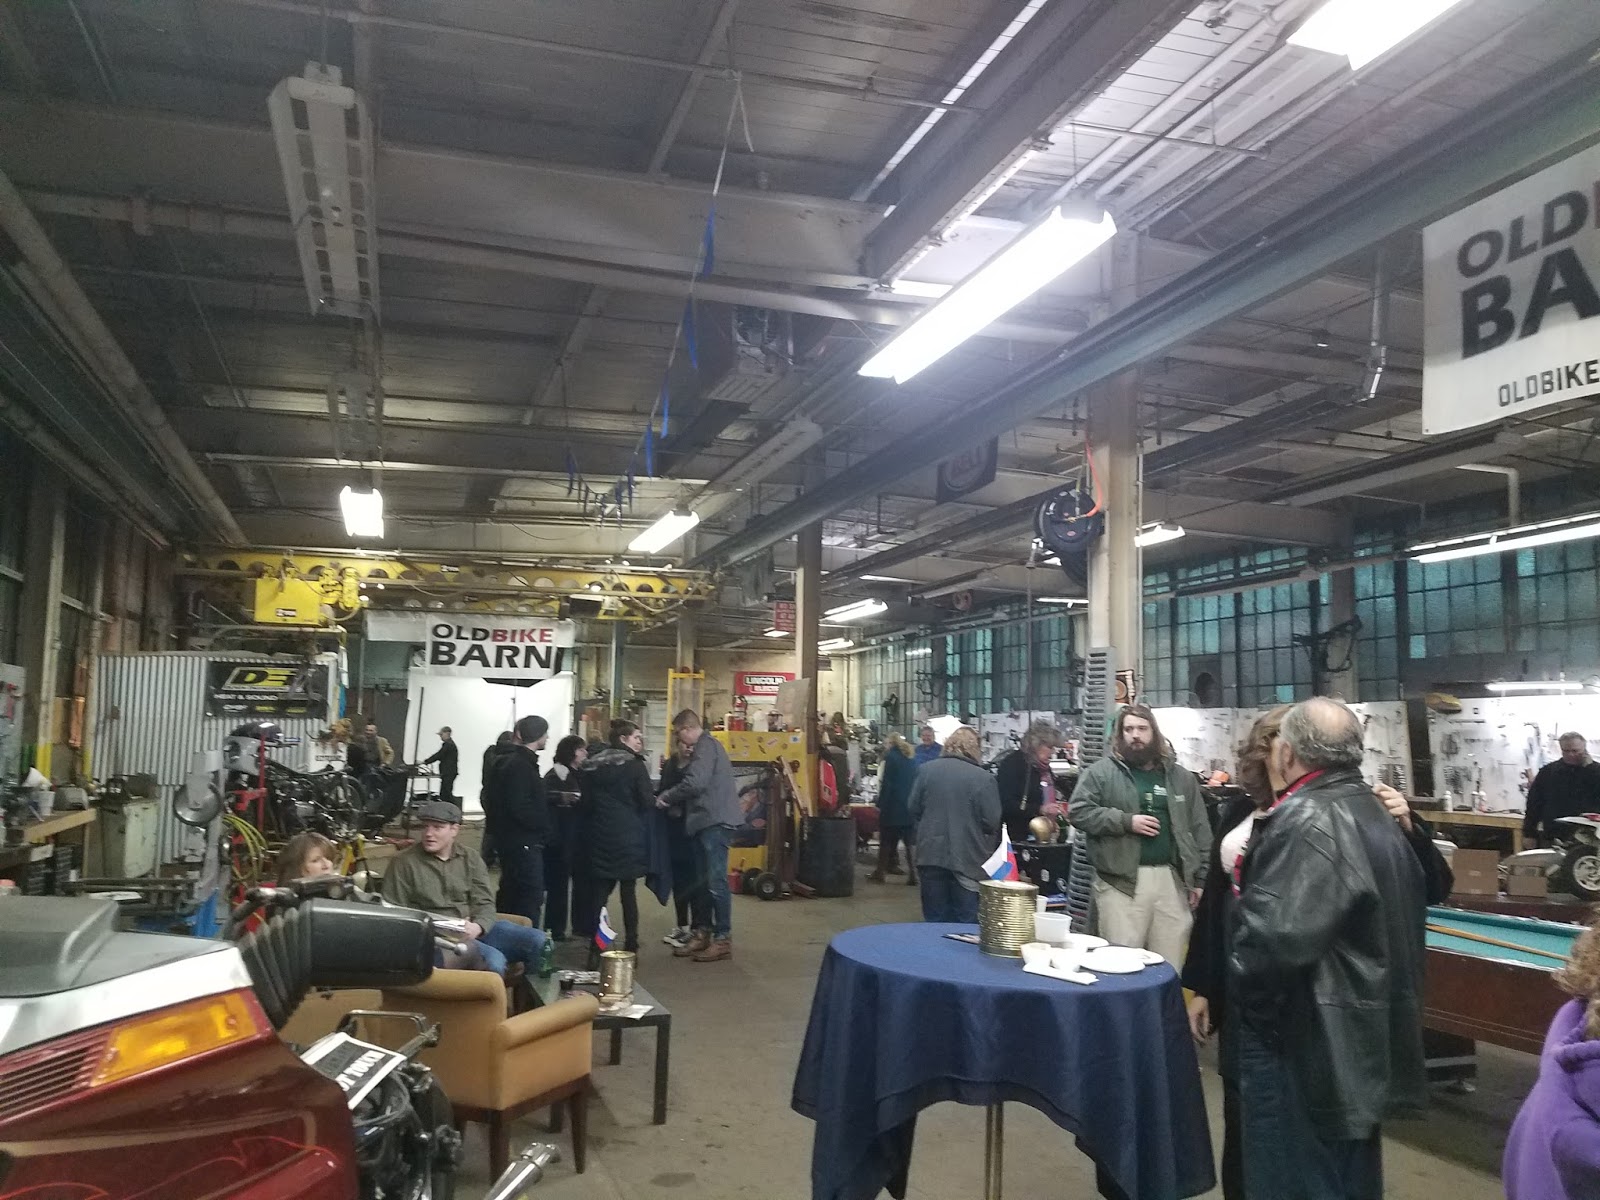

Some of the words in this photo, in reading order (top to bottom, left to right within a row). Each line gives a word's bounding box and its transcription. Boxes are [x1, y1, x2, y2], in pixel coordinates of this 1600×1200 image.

[1498, 360, 1600, 408] OLDBIKE
[432, 623, 554, 643] OLDBIKE
[430, 641, 552, 669] BARN
